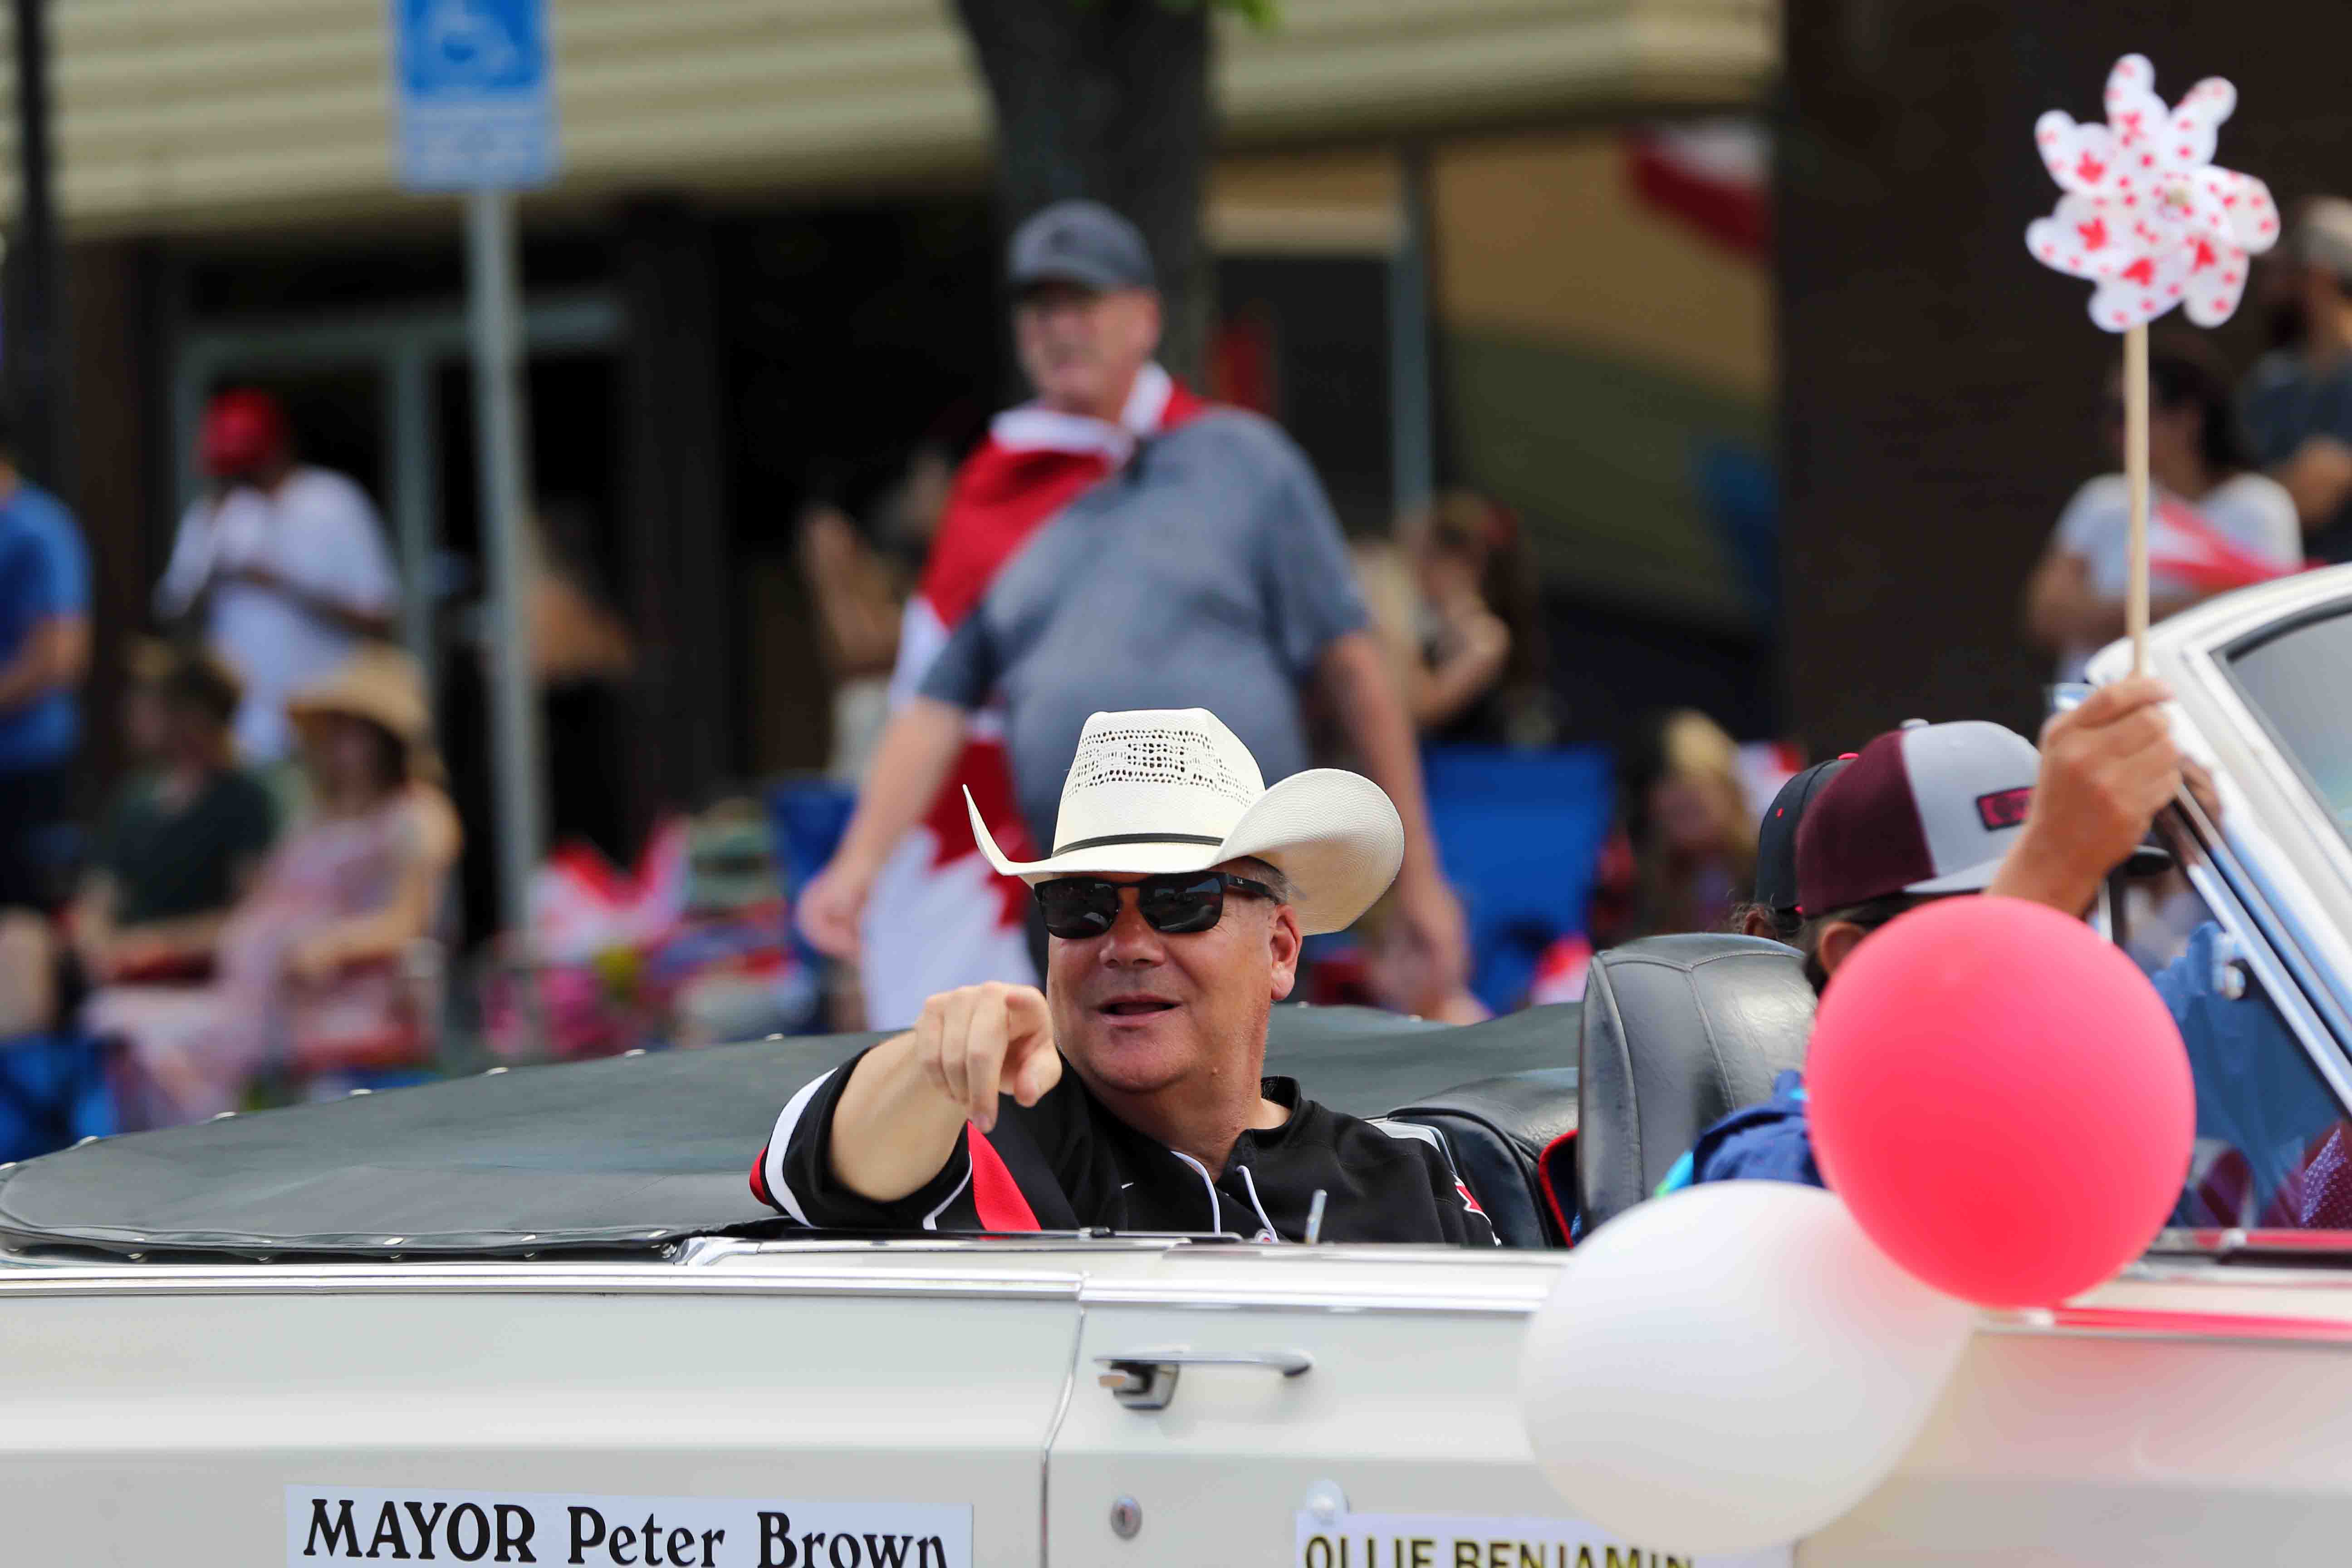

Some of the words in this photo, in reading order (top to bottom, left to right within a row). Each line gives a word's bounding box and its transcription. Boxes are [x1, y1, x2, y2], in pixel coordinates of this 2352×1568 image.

[304, 1499, 537, 1563] MAYOR
[567, 1506, 726, 1567] Peter
[757, 1511, 948, 1568] Brown
